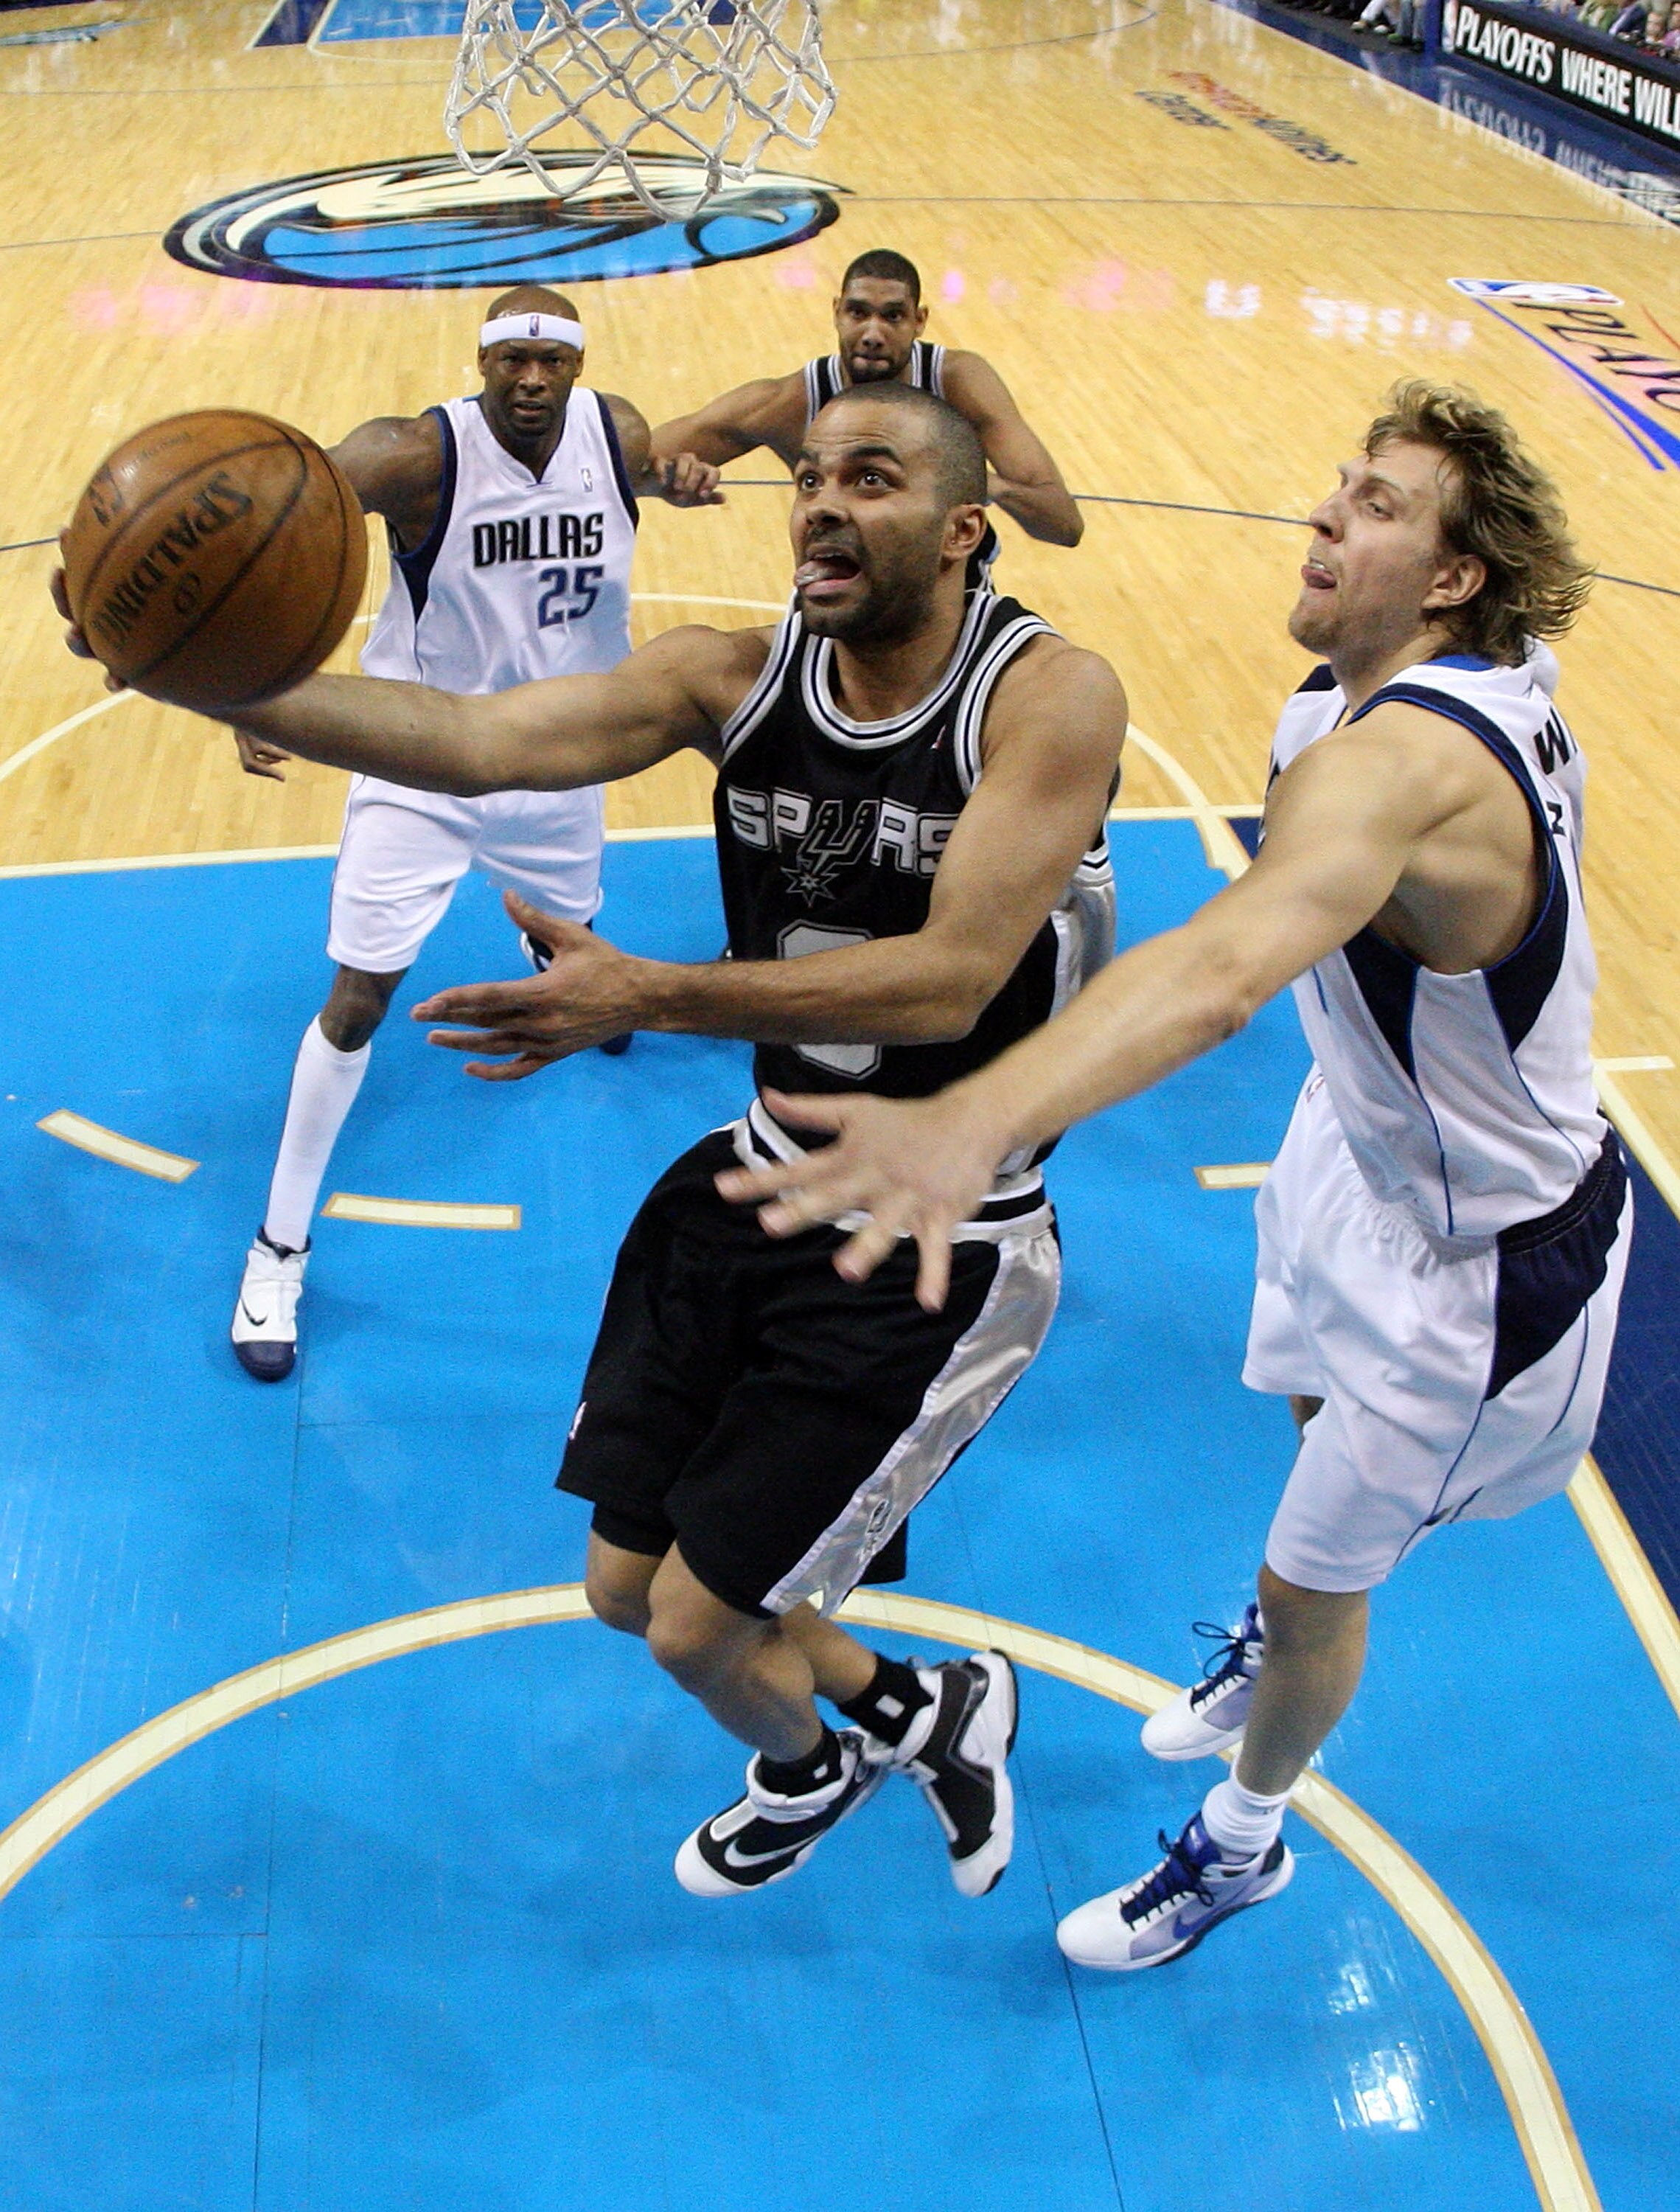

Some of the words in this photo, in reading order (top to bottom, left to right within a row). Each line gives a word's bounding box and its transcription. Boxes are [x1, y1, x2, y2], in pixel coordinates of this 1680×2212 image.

[1454, 4, 1555, 84] PLAYOFFS
[1561, 47, 1633, 116] WHERE
[473, 512, 604, 568] DALLAS
[537, 565, 604, 629] 25
[726, 784, 960, 879] SPURS
